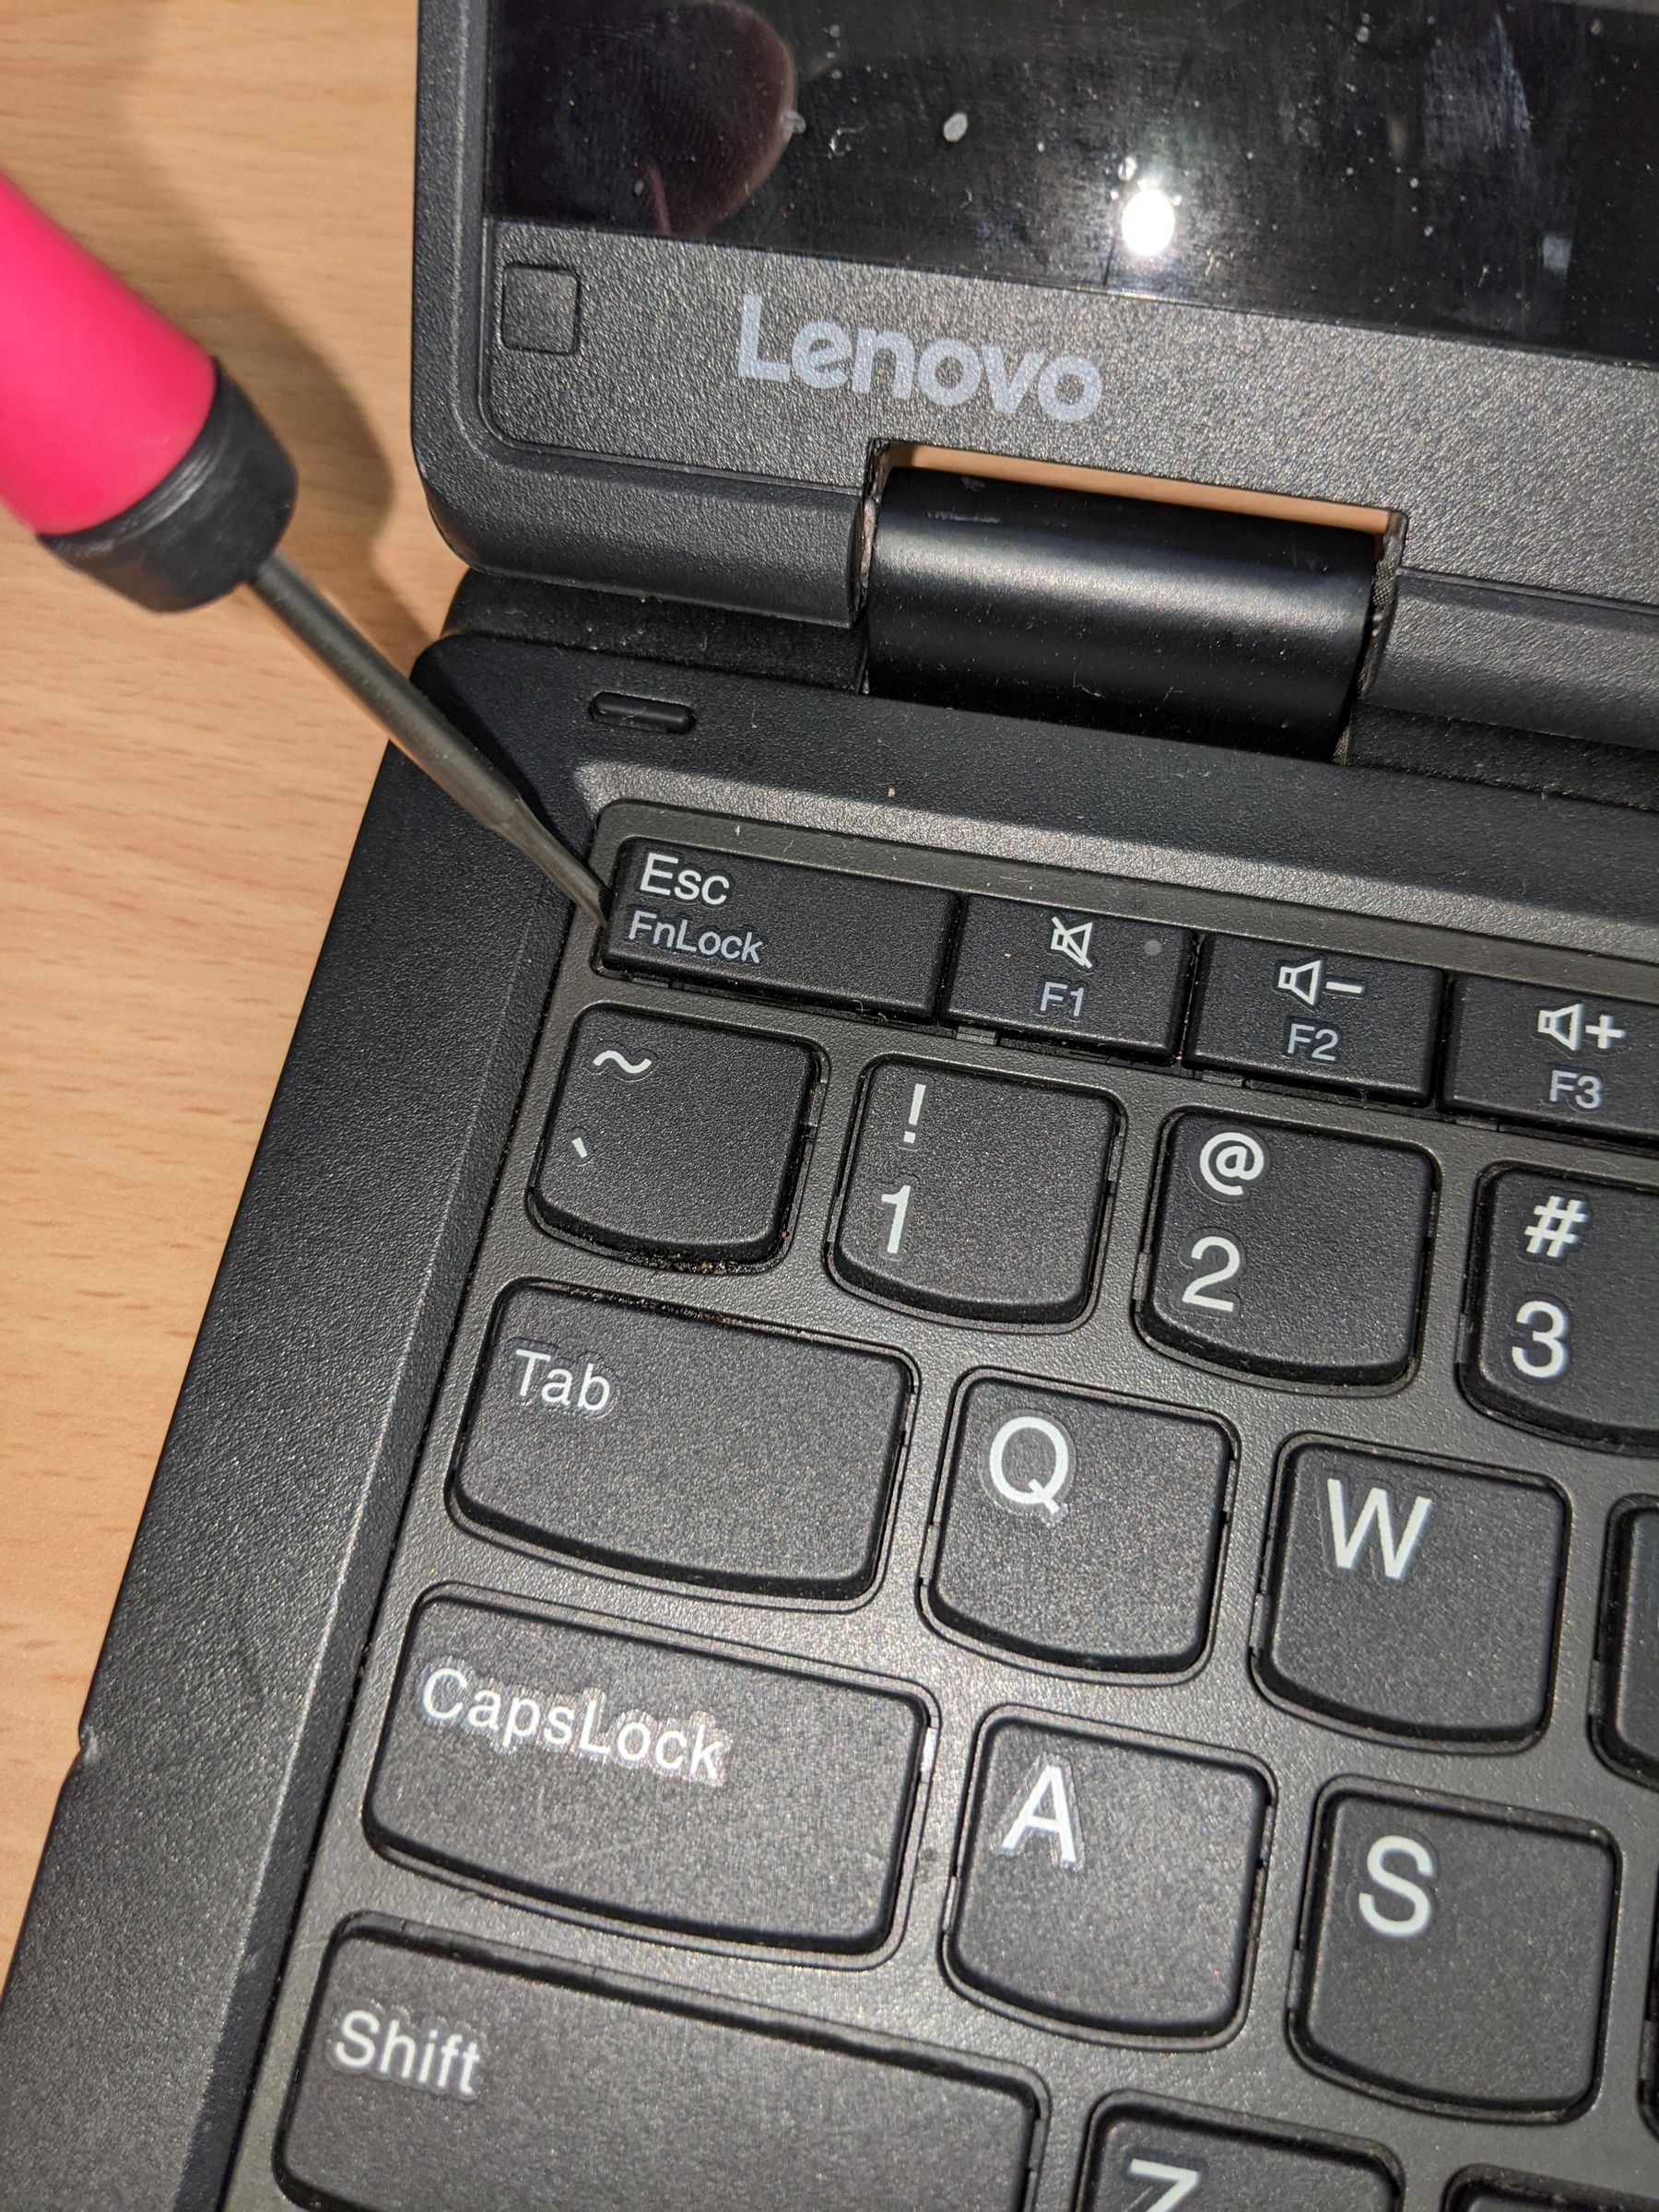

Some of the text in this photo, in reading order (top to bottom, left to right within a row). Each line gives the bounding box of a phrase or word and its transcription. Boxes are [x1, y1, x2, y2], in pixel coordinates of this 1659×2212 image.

[738, 291, 1103, 423] Lenovo
[640, 852, 730, 905] Esc
[628, 910, 763, 964] FnLock
[1040, 982, 1085, 1018] F1
[1287, 1023, 1338, 1062] F2
[1549, 1070, 1601, 1109] F3
[1199, 1132, 1265, 1196] @
[881, 1184, 912, 1254] 1
[1524, 1195, 1586, 1258] #
[1182, 1236, 1241, 1312] 2
[1512, 1300, 1566, 1378] 3
[515, 1348, 610, 1414] Tab
[989, 1416, 1069, 1516] Q
[1327, 1478, 1432, 1579] W
[423, 1667, 724, 1787] CapsLock
[1001, 1762, 1077, 1863] A
[1359, 1835, 1433, 1936] S
[335, 2010, 480, 2095] Shift
